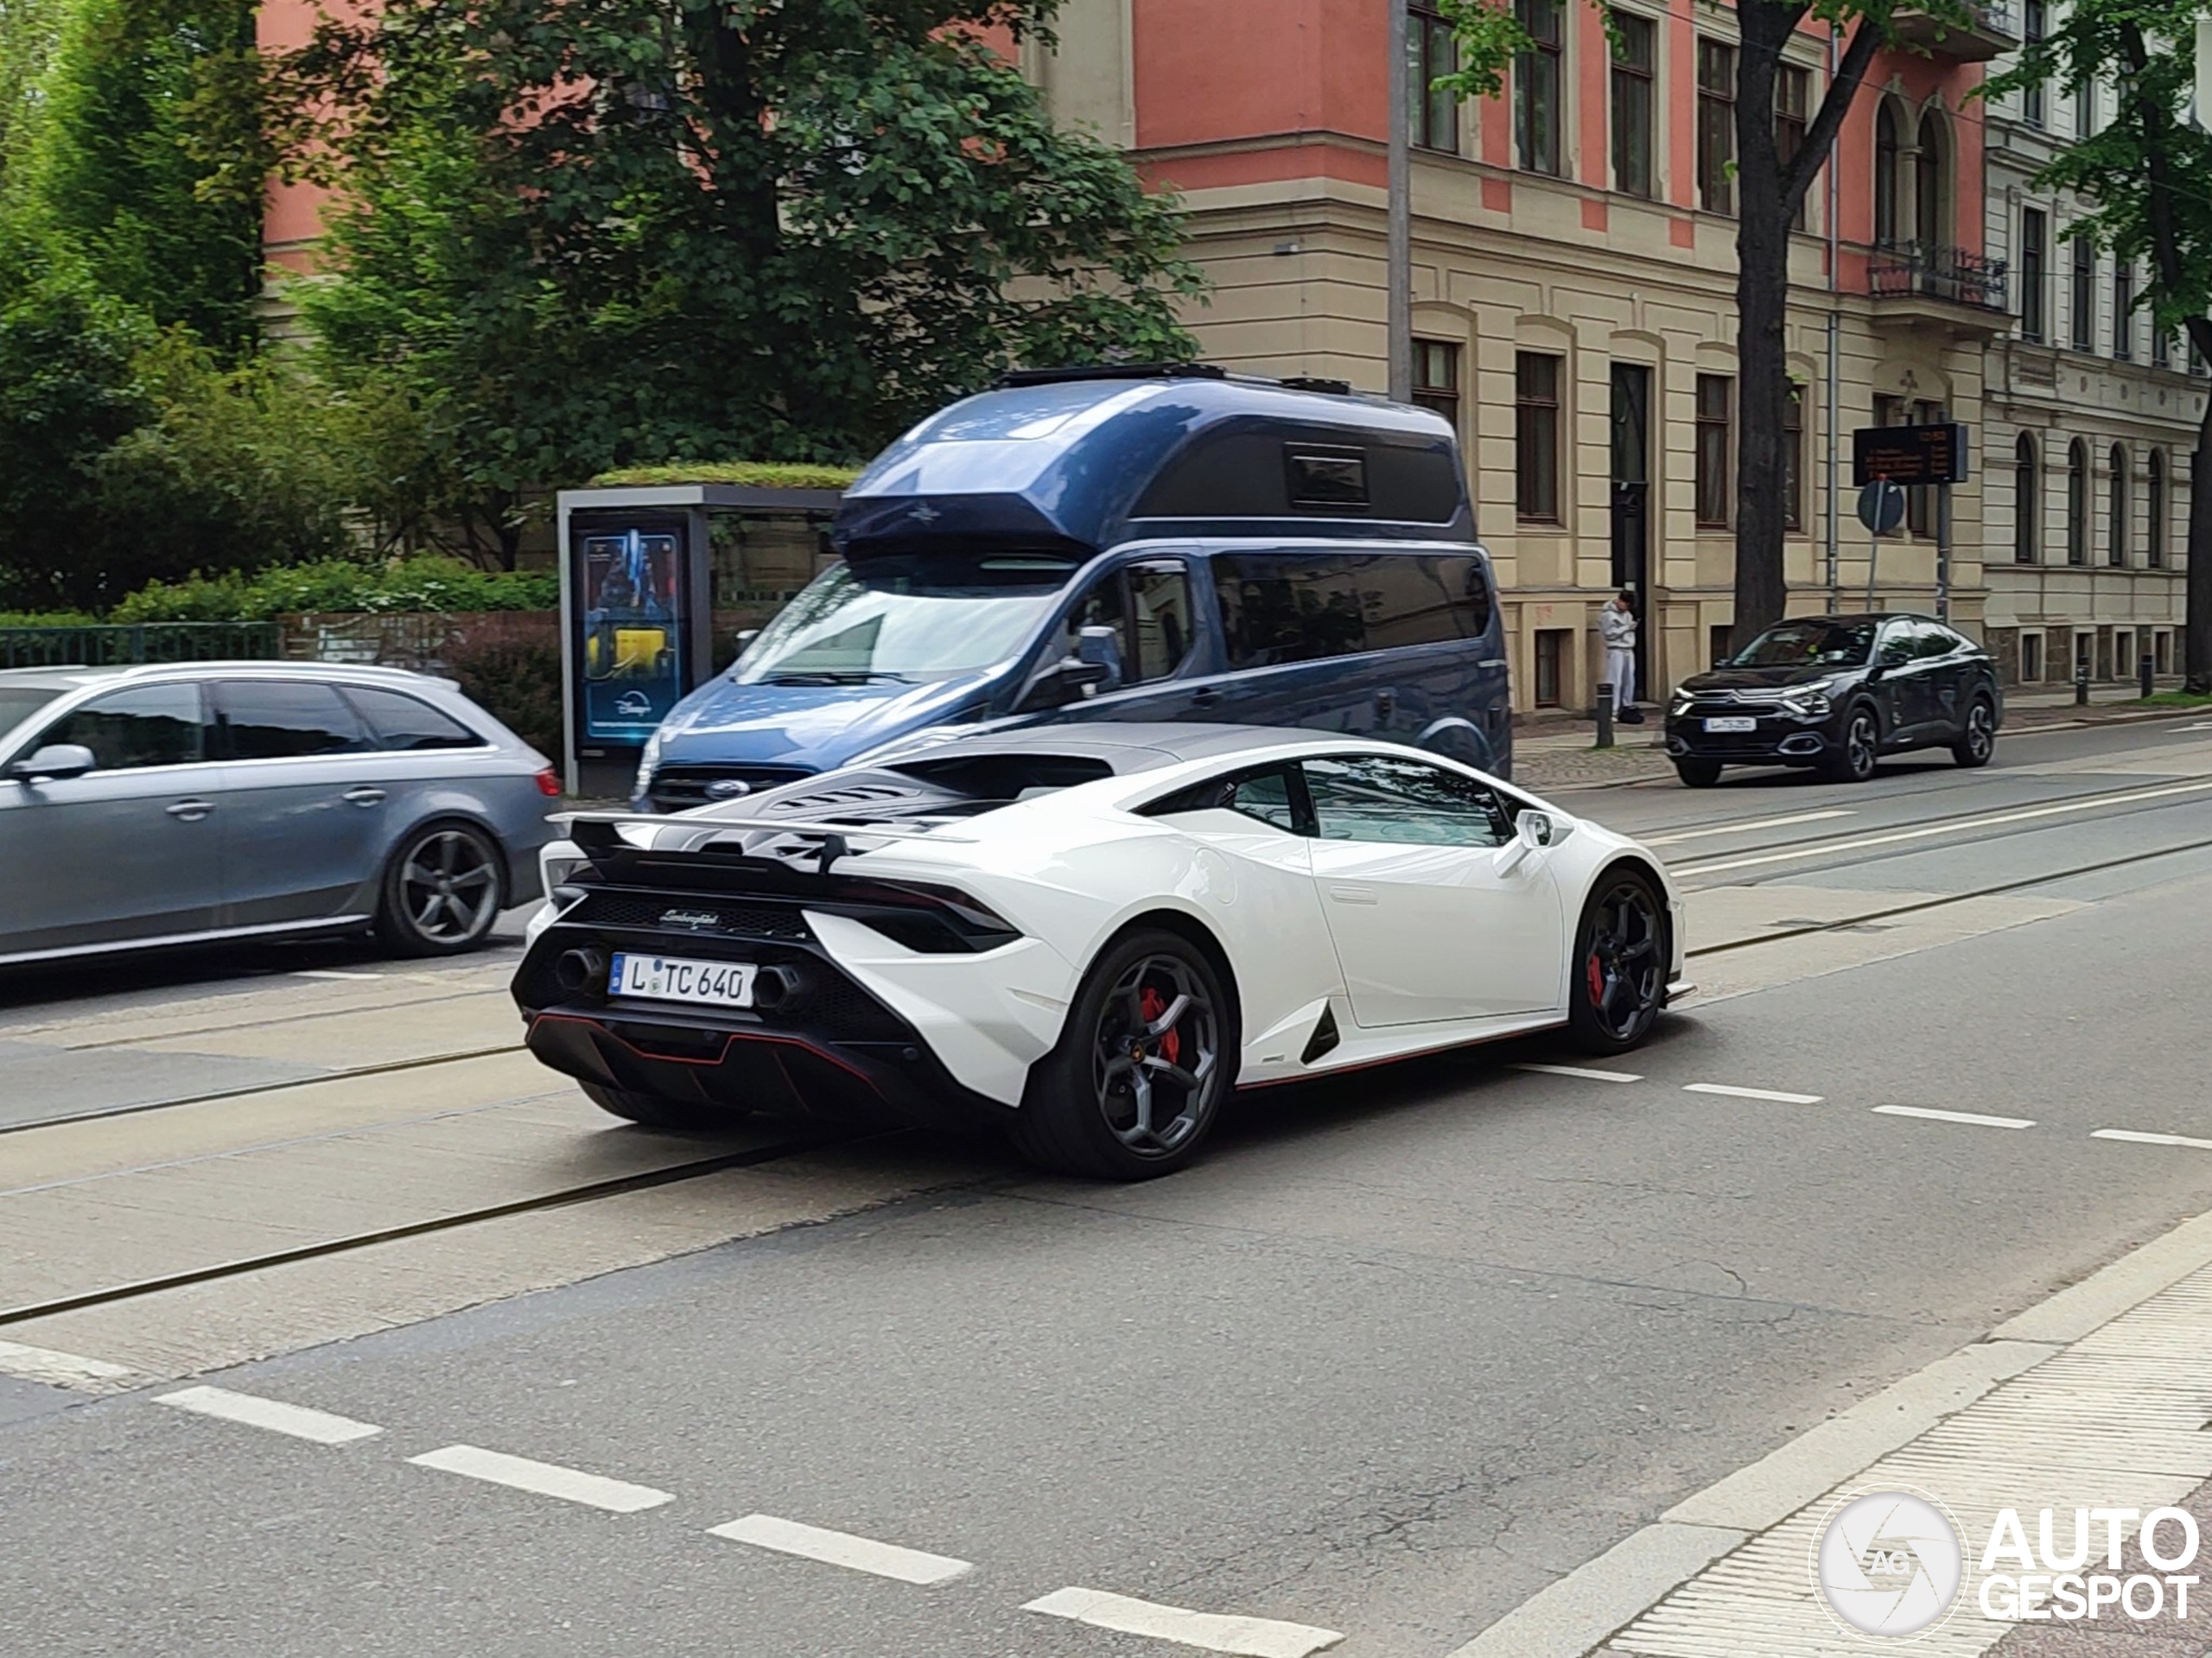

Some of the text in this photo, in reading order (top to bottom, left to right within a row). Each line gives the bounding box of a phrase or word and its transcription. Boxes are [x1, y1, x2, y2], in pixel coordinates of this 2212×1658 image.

[632, 962, 743, 999] L TC 640
